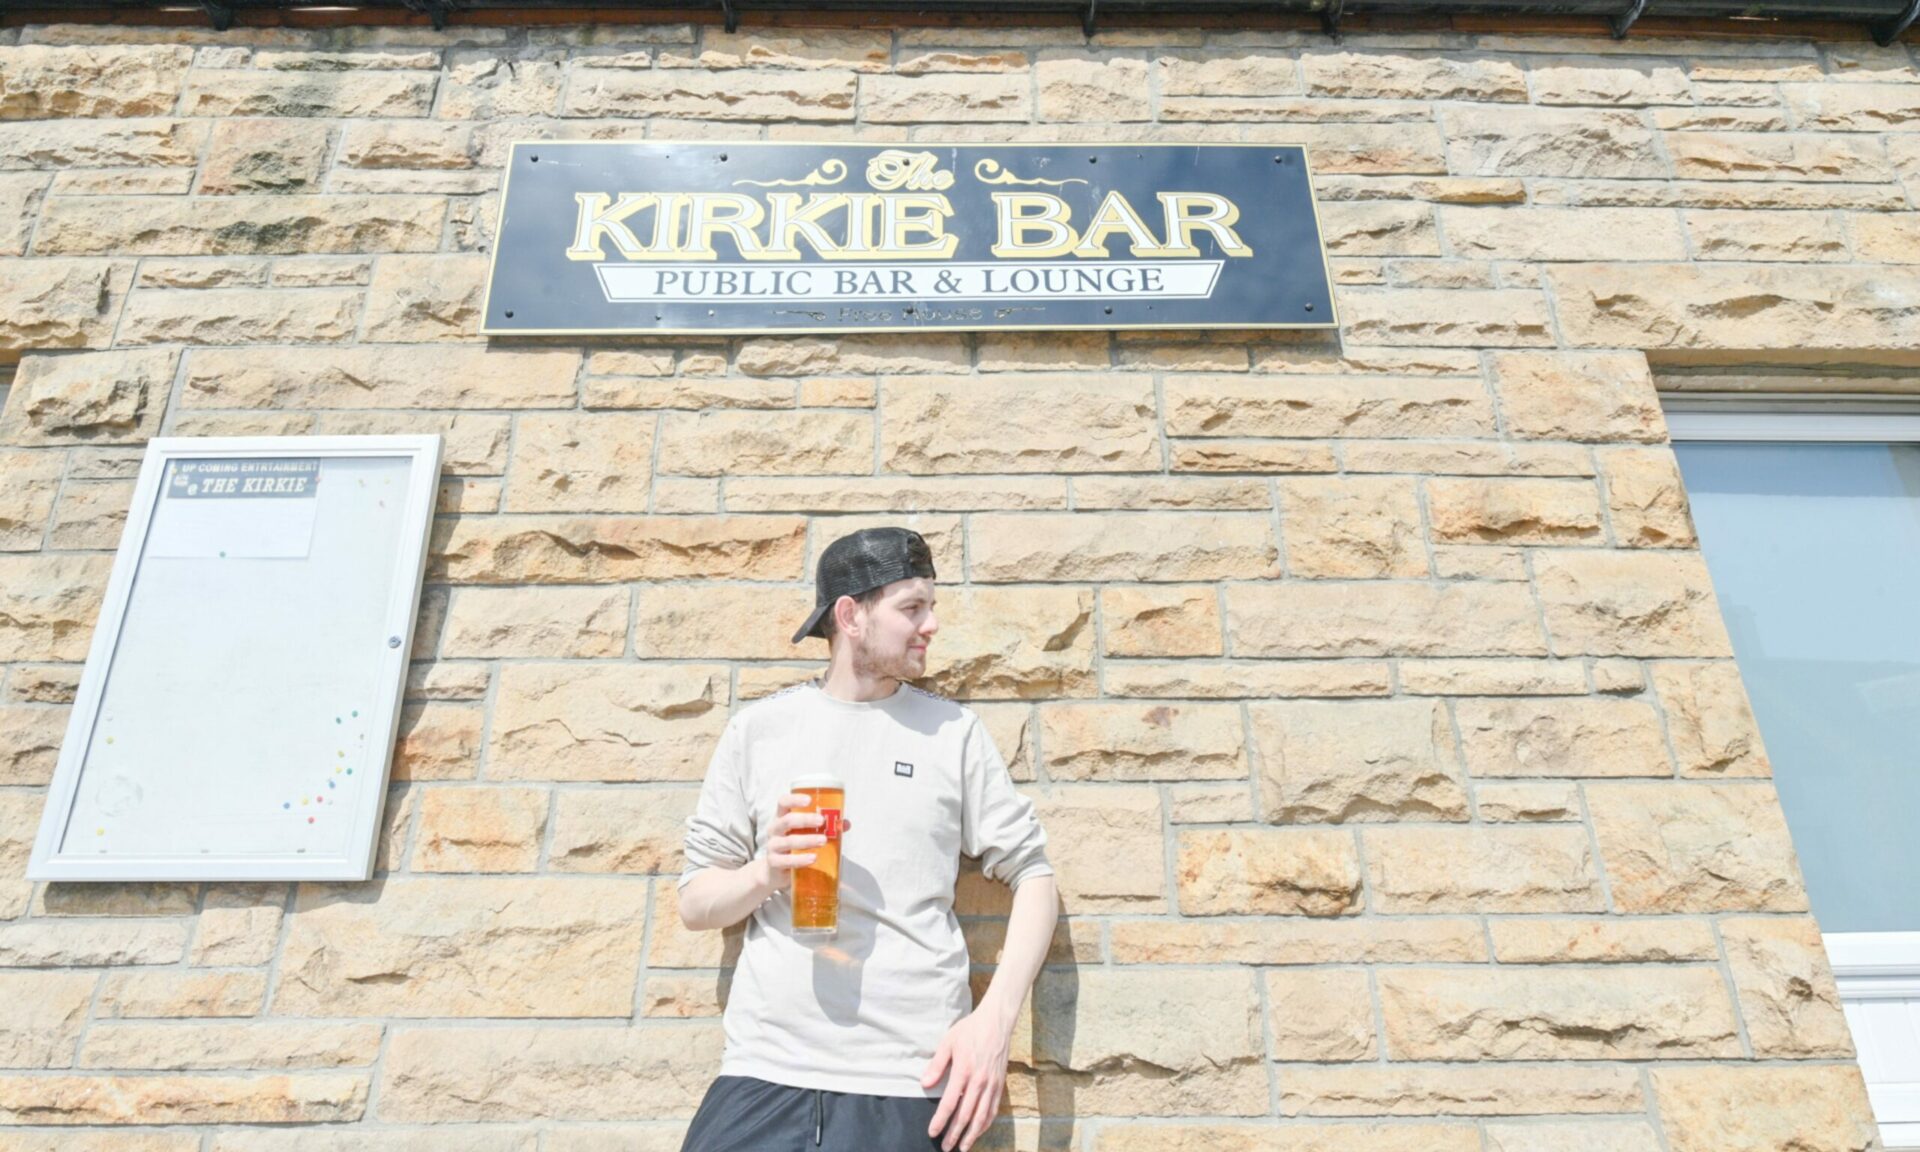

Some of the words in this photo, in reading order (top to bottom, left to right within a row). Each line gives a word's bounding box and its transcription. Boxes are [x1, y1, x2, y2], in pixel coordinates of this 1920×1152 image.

[866, 149, 955, 190] The
[566, 191, 960, 260] KIRKIE
[991, 190, 1253, 258] BAR
[653, 270, 812, 296] PUBLIC
[833, 270, 918, 295] BAR
[933, 269, 962, 293] &
[981, 267, 1165, 293] LOUNGE
[202, 477, 238, 493] THE
[241, 476, 308, 493] KIRKIE
